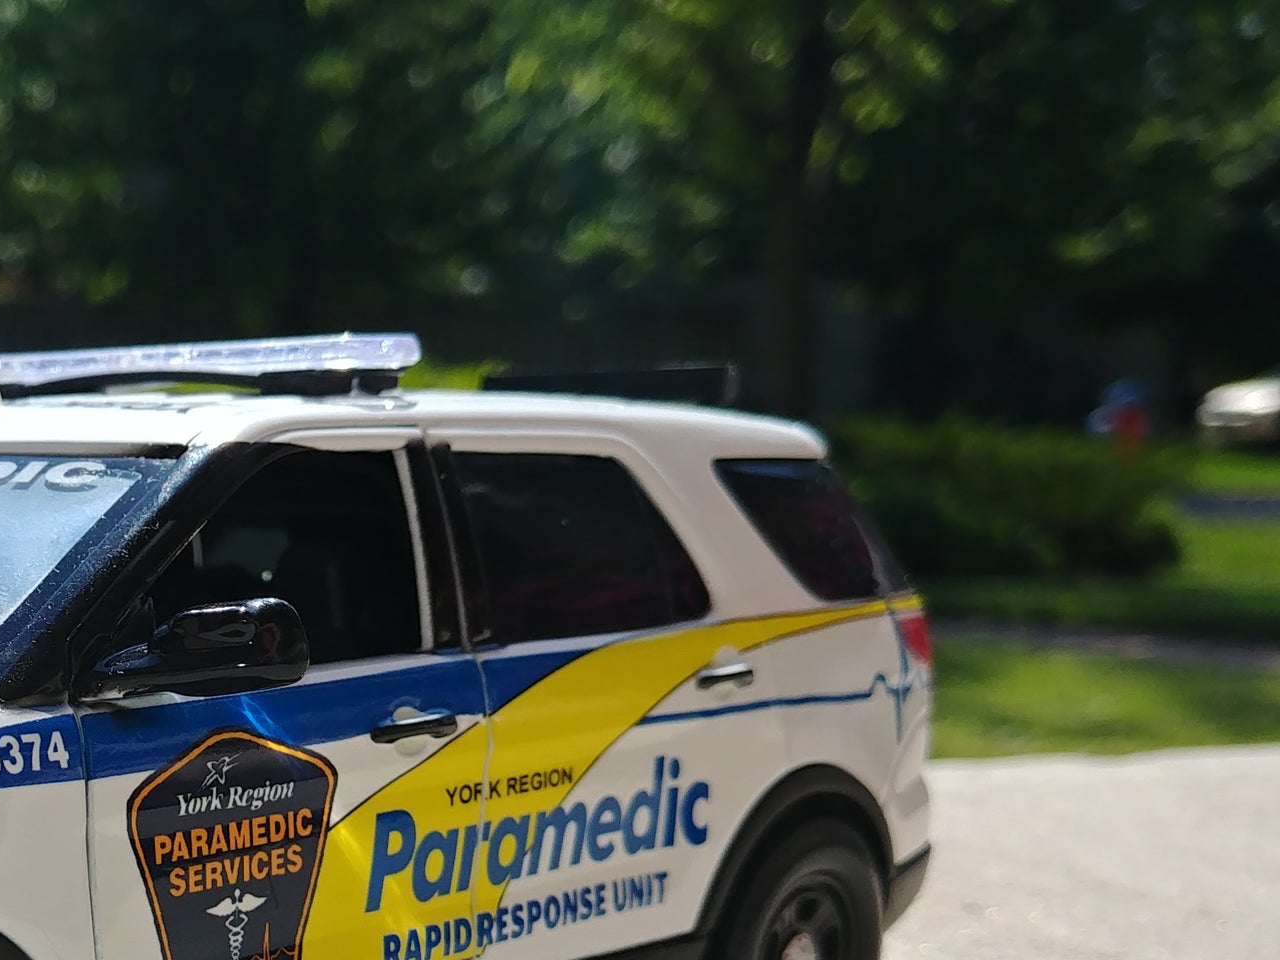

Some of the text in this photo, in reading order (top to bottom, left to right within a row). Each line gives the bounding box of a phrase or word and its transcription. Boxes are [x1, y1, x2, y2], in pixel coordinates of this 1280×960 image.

[176, 781, 295, 817] York Region
[446, 766, 574, 807] YORK REGION
[154, 808, 314, 865] PARAMEDIC
[364, 755, 711, 913] Paramedic
[169, 844, 303, 898] SERVICES
[476, 886, 606, 947] RESPONSE
[612, 871, 669, 914] UNIT
